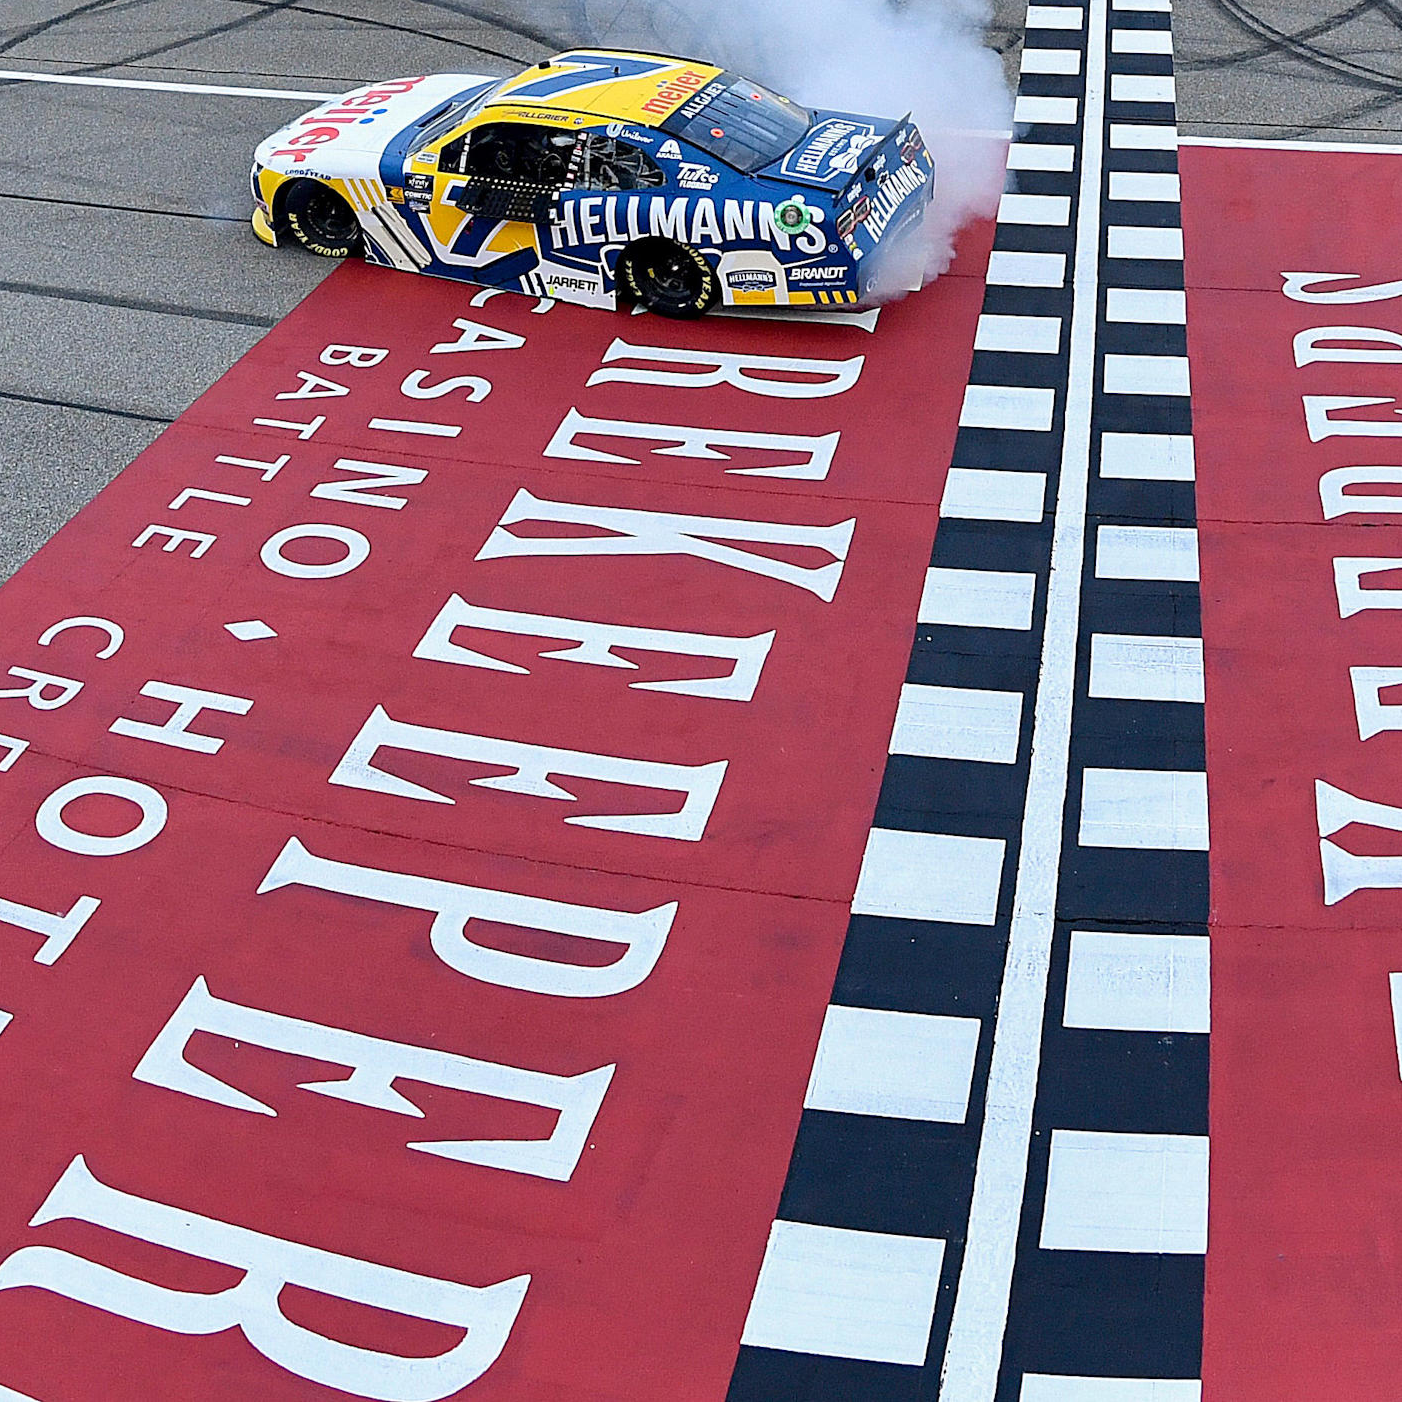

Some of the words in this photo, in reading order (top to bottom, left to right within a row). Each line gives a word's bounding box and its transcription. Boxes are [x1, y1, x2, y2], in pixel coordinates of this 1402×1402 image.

[496, 51, 688, 103] 7
[641, 69, 707, 116] meijer
[680, 81, 727, 120] ALLGAIER
[270, 75, 426, 163] meijer
[620, 128, 654, 144] Unilever
[408, 175, 430, 189] xfinity
[676, 162, 720, 184] Tufco
[546, 274, 599, 291] JARRETT
[728, 271, 774, 284] HELLMANN'S
[788, 266, 848, 281] BRANDT
[132, 341, 390, 560] BATTLE
